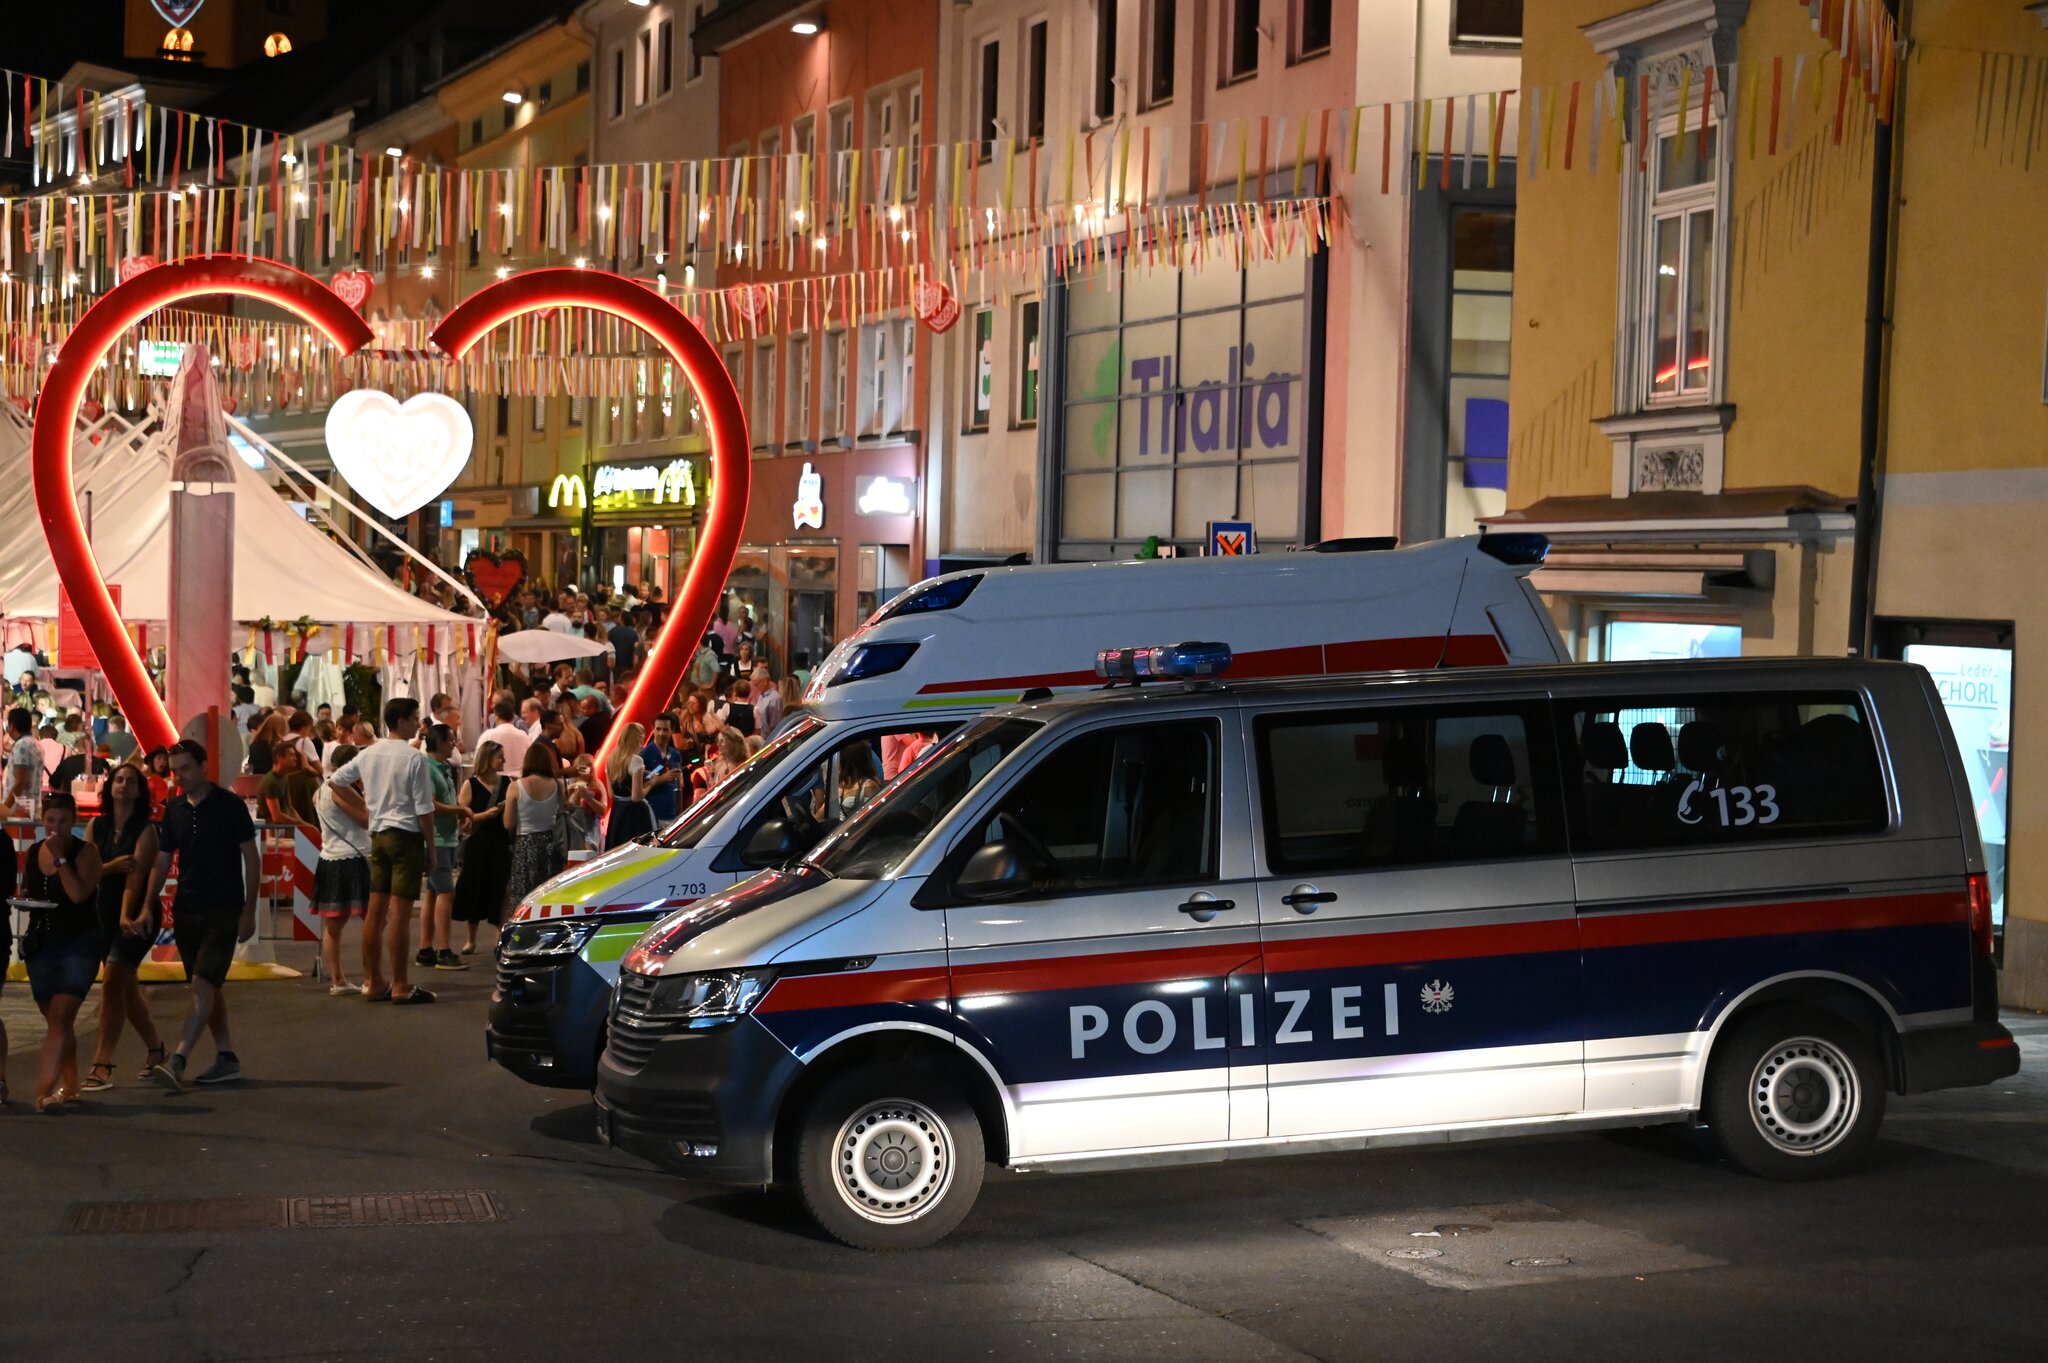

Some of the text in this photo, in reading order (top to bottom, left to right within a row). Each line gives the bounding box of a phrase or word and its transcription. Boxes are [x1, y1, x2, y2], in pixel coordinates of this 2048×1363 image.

[1131, 342, 1291, 456] Thalia
[1937, 680, 1998, 704] CHORL
[1709, 784, 1780, 827] 133
[668, 882, 706, 897] 7.703
[1069, 983, 1399, 1059] POLIZEI
